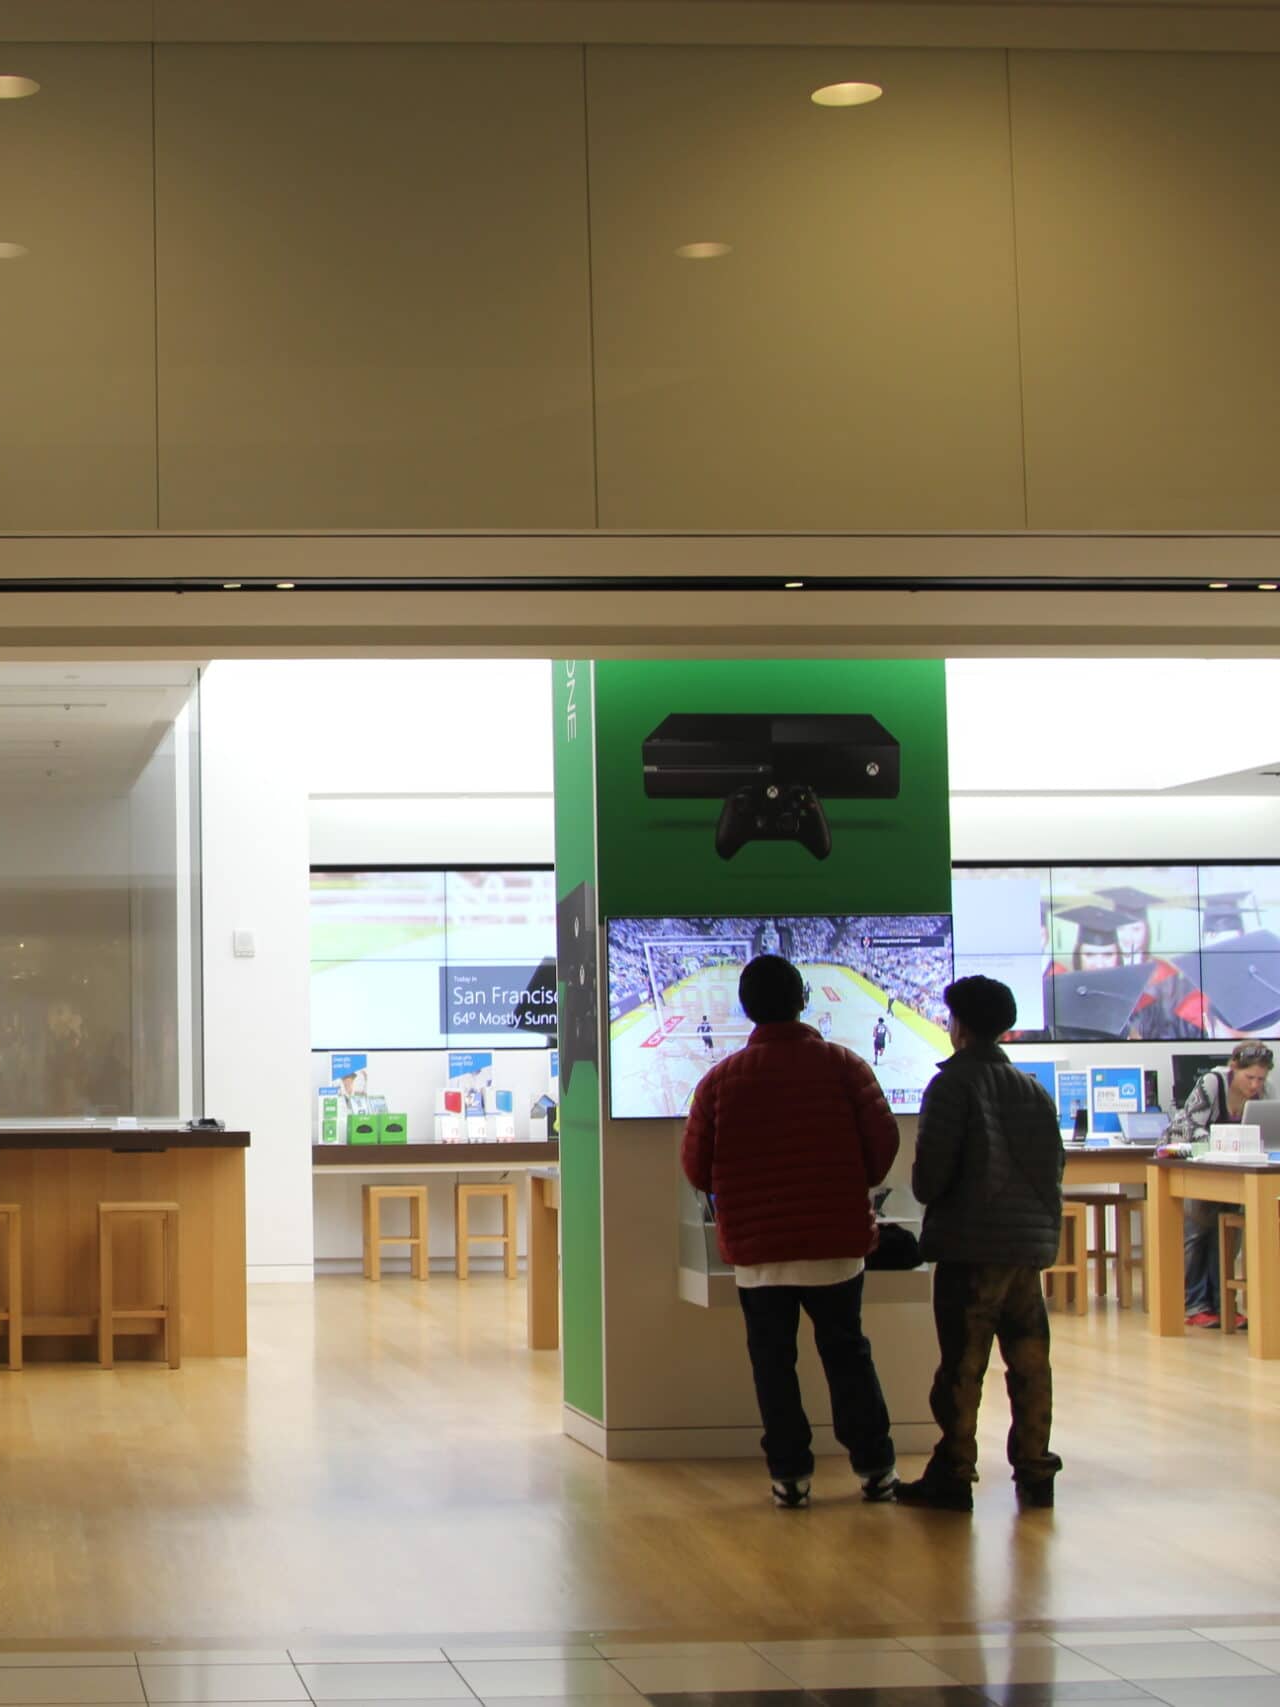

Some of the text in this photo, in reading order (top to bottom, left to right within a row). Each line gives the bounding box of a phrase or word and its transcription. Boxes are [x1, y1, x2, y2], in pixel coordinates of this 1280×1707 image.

[453, 986, 558, 1005] San Francis
[479, 1011, 522, 1029] Mostly
[525, 1011, 558, 1025] Sunn
